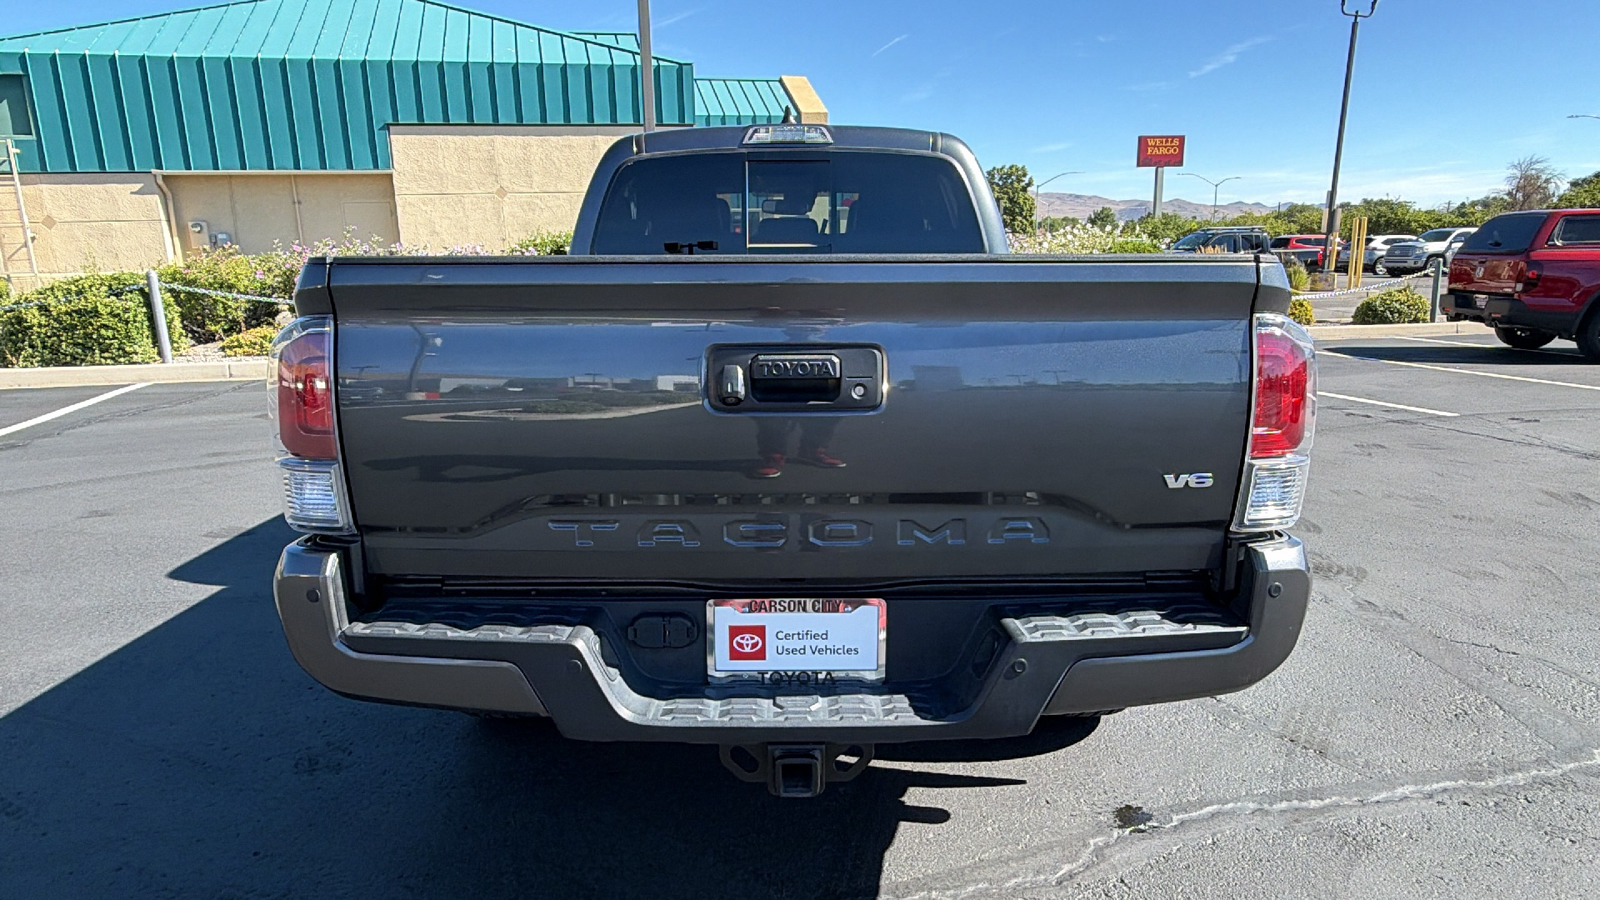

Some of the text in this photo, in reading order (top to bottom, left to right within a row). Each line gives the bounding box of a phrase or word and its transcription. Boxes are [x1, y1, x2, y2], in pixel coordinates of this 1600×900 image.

[1146, 138, 1180, 146] WELLS
[1146, 146, 1179, 155] FARGO
[759, 361, 835, 376] TOYOTA
[1163, 472, 1214, 489] V6
[547, 516, 1050, 547] TACOMA
[749, 599, 842, 613] CARSON CITY
[775, 630, 829, 641] Certified
[775, 645, 859, 656] Used Vehicles
[758, 671, 836, 685] TOYOTA
